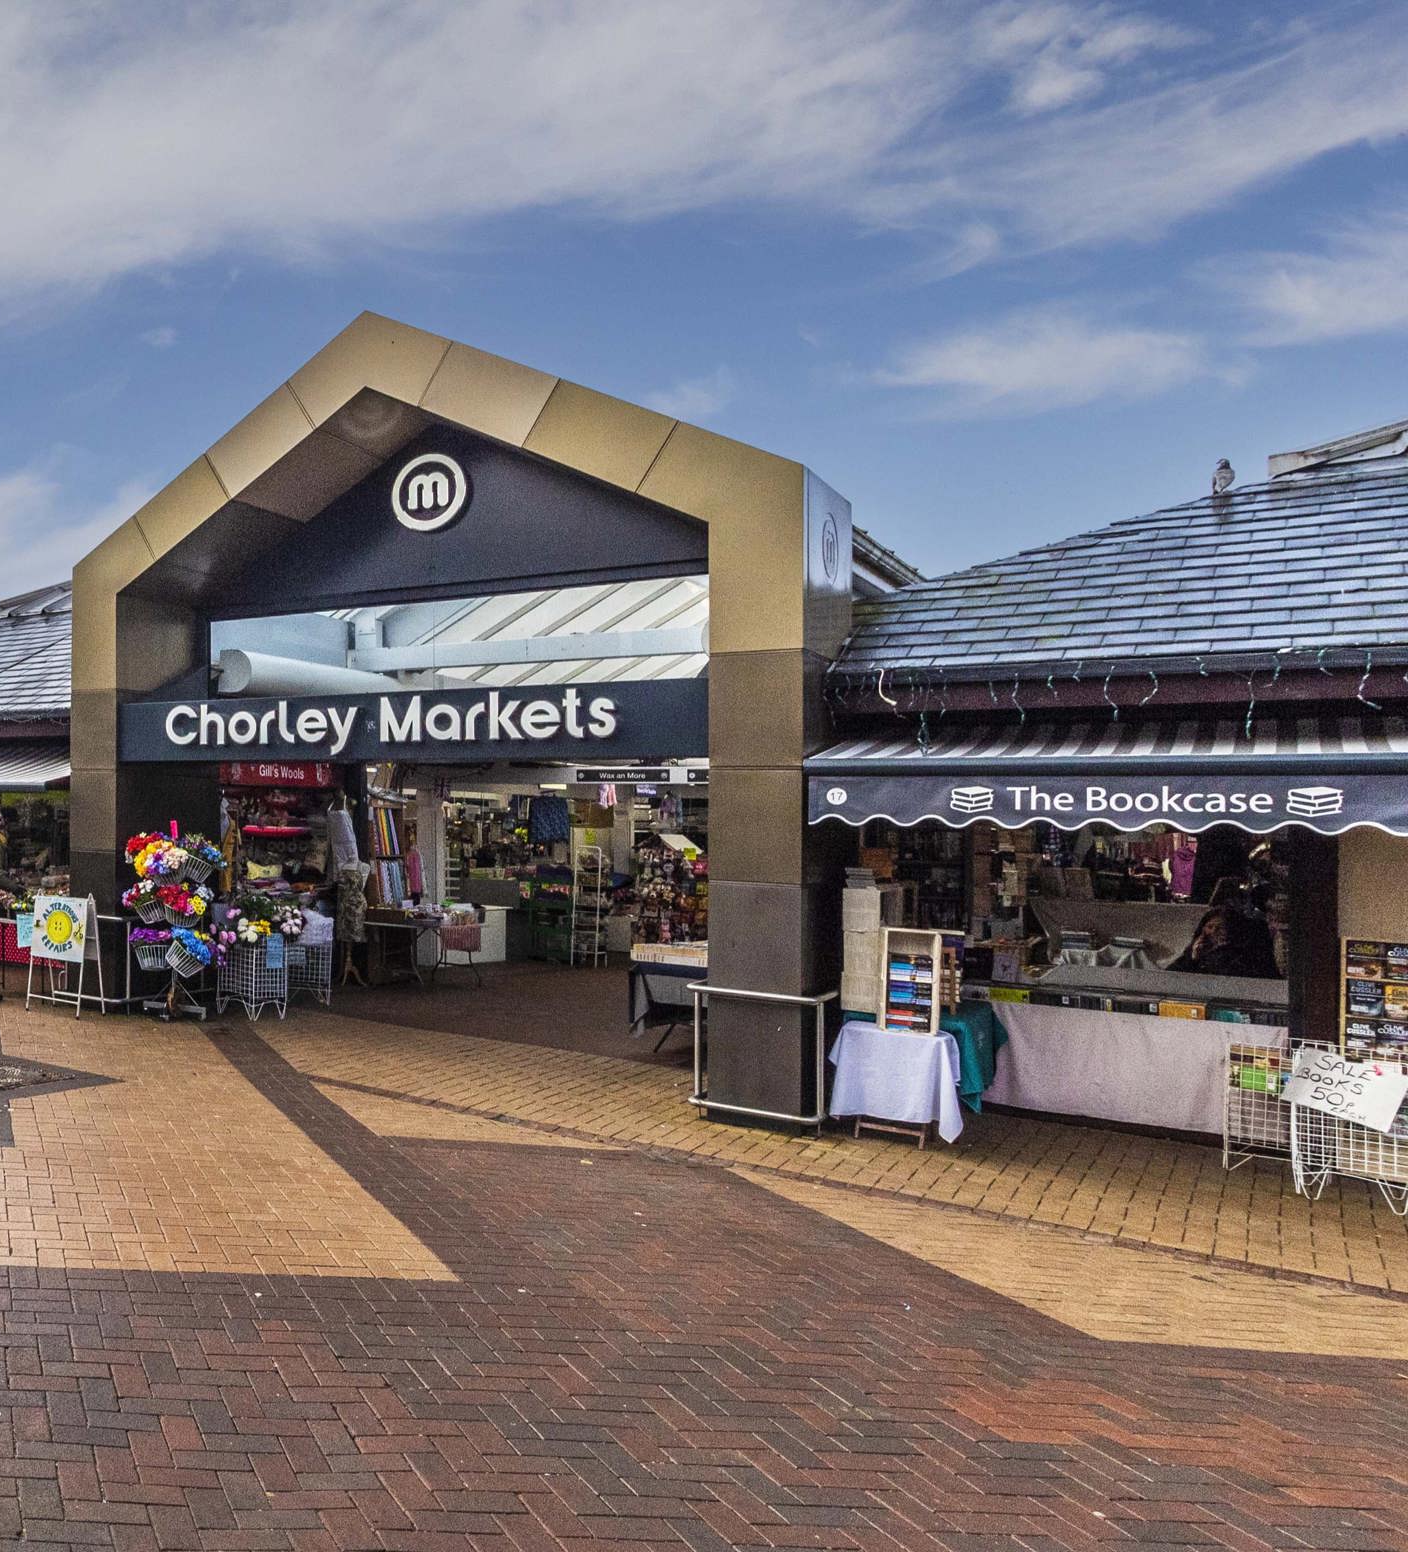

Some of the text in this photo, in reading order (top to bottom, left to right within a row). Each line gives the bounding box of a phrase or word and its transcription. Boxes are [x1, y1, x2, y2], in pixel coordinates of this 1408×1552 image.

[165, 687, 616, 756] Chorley Markets
[259, 764, 305, 780] Gill's Wools
[831, 791, 843, 801] 17
[1006, 786, 1273, 813] The Bookcase
[41, 934, 73, 953] REPAIRS
[1296, 1067, 1364, 1095] BOOKS
[1314, 1055, 1372, 1081] SALE
